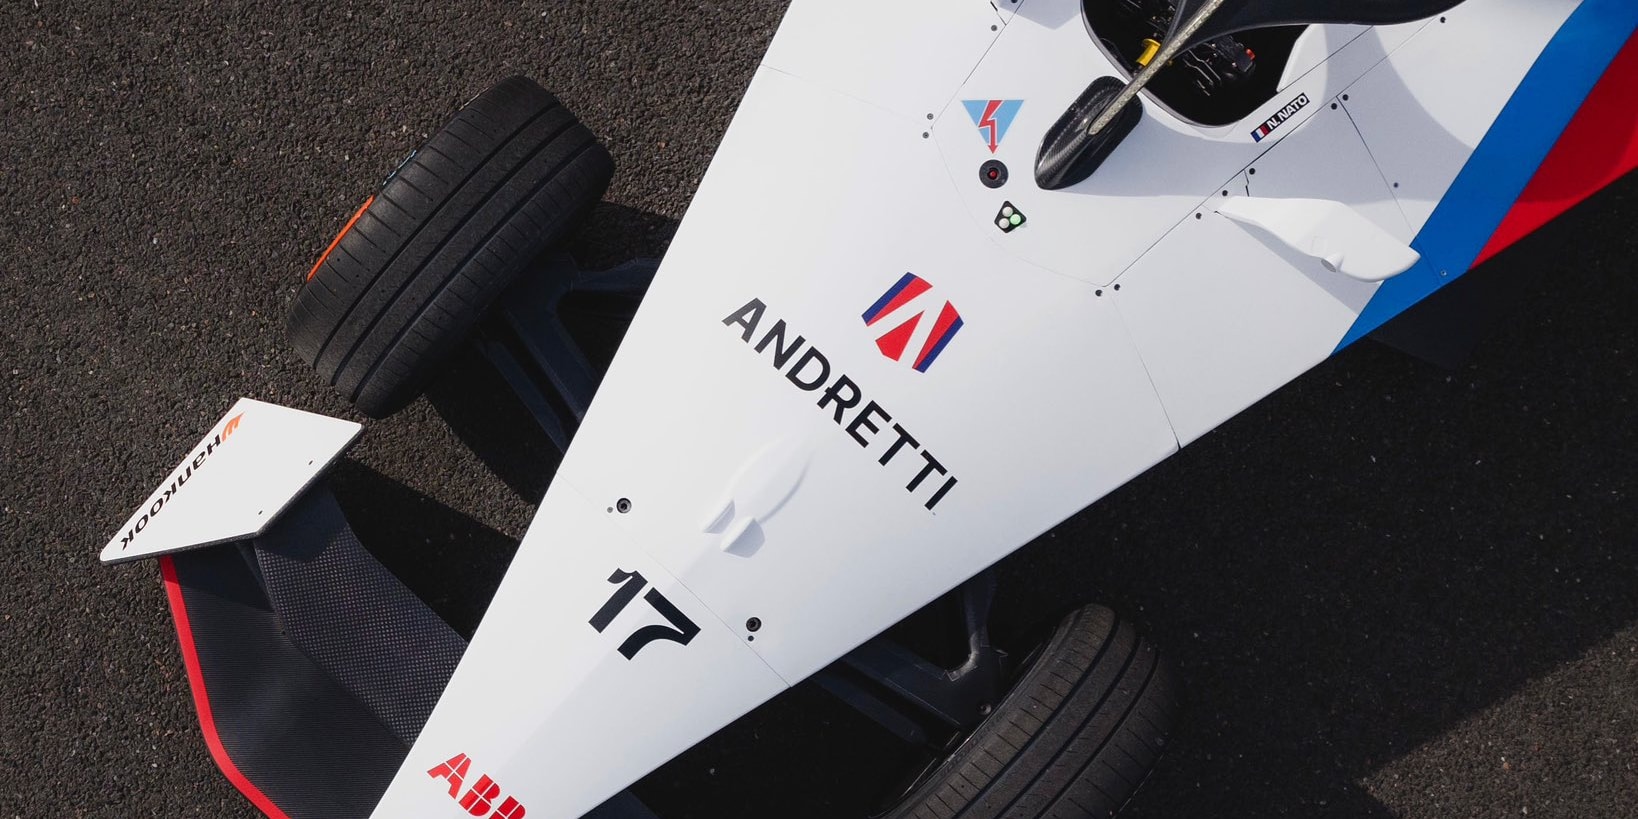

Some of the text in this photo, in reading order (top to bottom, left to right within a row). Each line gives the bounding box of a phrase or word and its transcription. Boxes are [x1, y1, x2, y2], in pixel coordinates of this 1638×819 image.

[1266, 95, 1307, 130] N. NATO
[722, 297, 958, 511] ANDRETTI
[588, 567, 702, 661] 17
